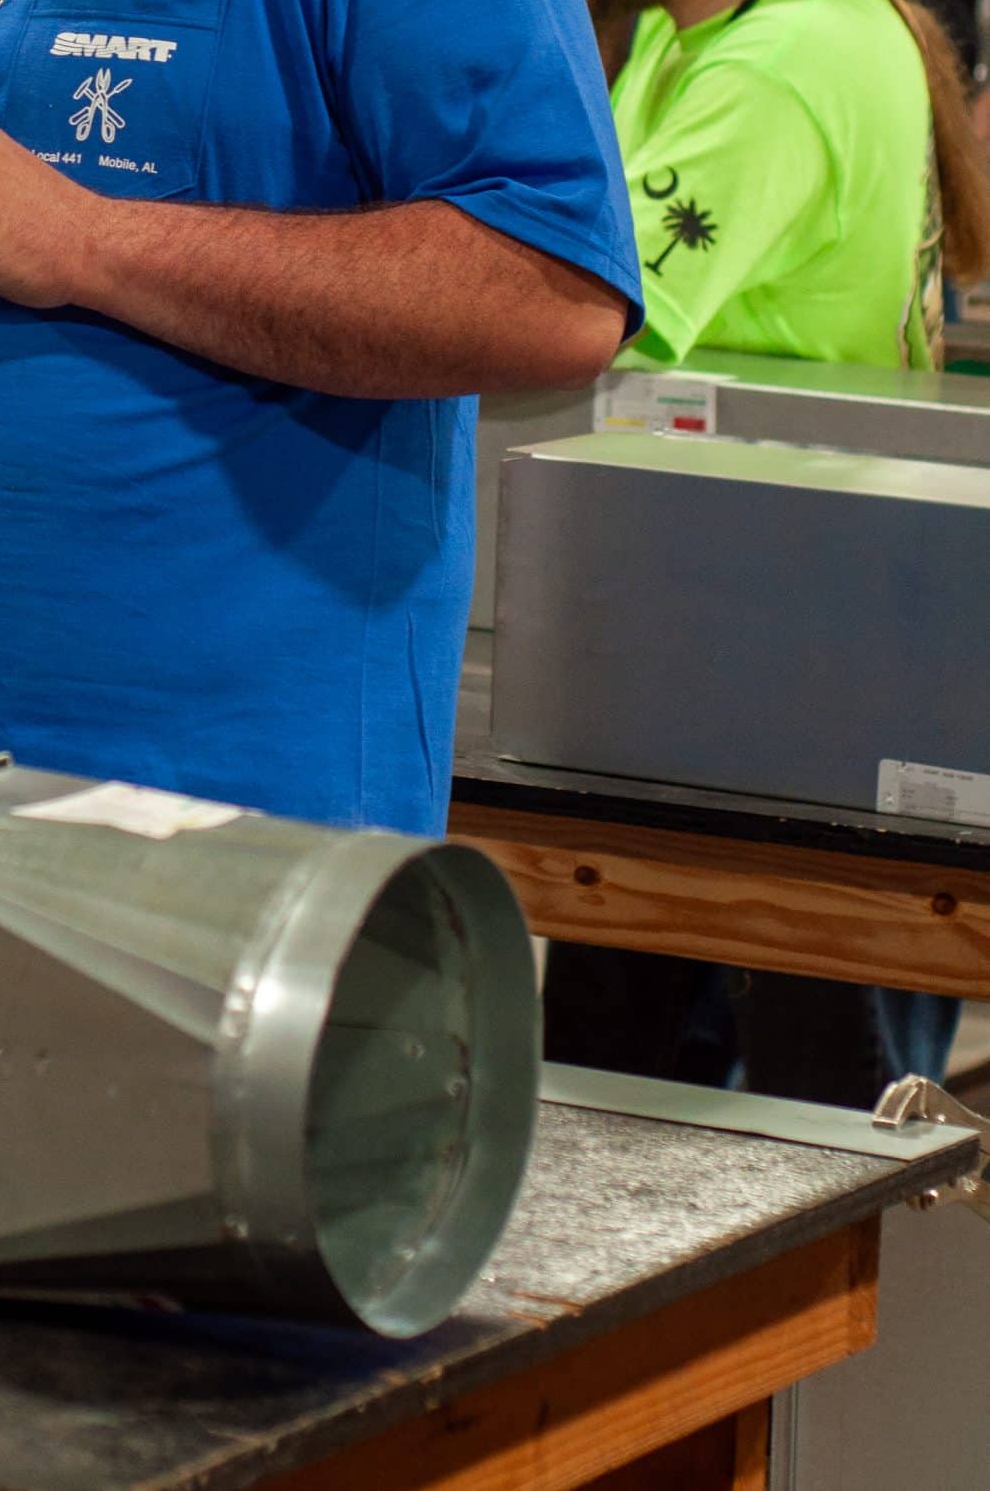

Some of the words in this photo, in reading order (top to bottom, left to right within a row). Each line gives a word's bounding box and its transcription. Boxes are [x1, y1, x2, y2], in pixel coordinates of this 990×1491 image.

[49, 31, 178, 62] SMART
[61, 152, 82, 164] 441
[98, 155, 139, 173] Mobile,
[141, 162, 158, 174] AL
